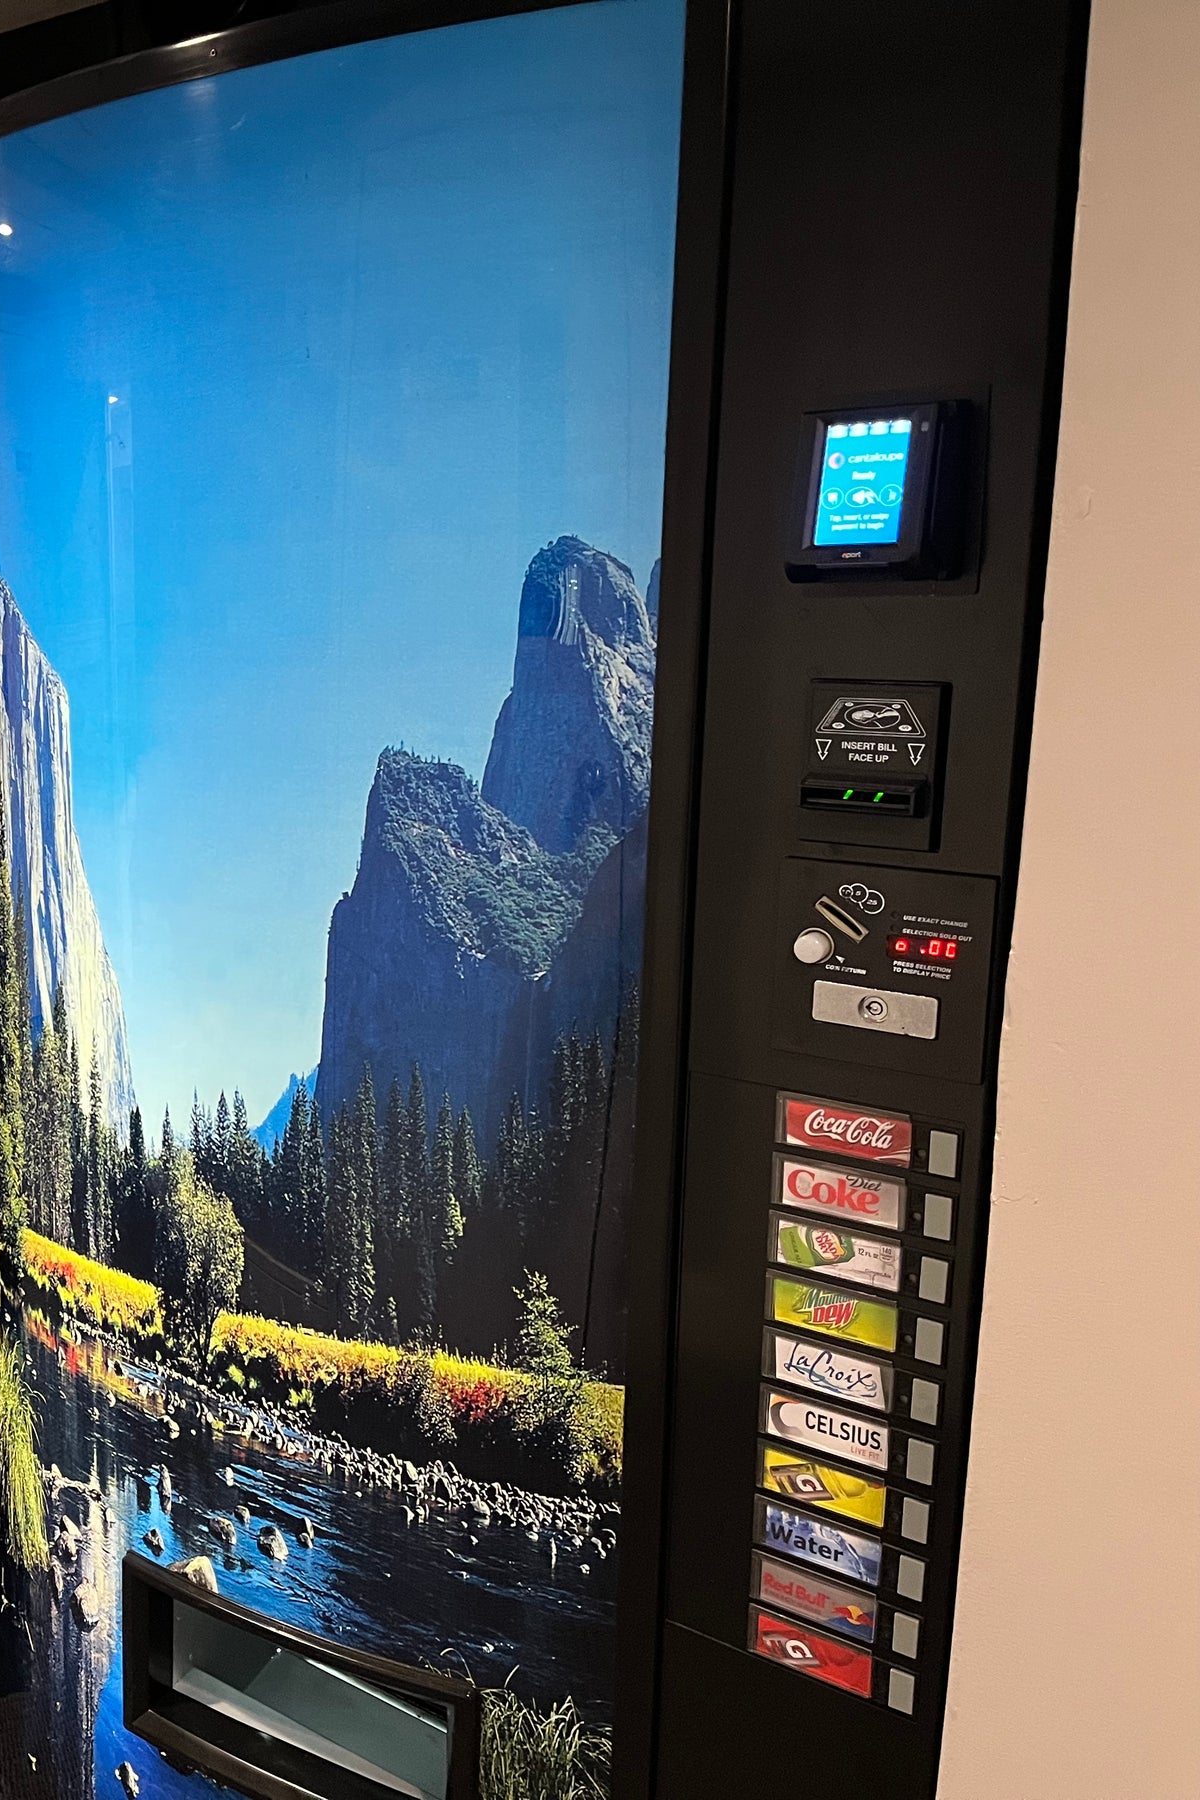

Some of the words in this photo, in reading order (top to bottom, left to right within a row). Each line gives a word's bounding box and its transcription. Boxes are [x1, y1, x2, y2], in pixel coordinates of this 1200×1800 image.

[848, 452, 904, 463] cantaloupe
[841, 741, 875, 751] INSERT
[878, 743, 898, 752] BILL
[849, 753, 873, 762] FACE
[875, 754, 889, 763] UP
[917, 916, 940, 924] EXACT
[940, 920, 968, 928] CHANGE
[902, 928, 938, 938] SELECTION
[893, 960, 914, 968] PRESS
[915, 963, 951, 973] SELECTION
[902, 968, 930, 976] DISPLAY
[930, 972, 951, 980] PRICE
[804, 1109, 896, 1149] Coca-Cola
[846, 1173, 882, 1192] Diet
[787, 1169, 880, 1214] Coke
[816, 1230, 840, 1260] ANADA
[816, 1236, 830, 1254] DRY
[858, 1248, 864, 1256] 12
[850, 1445, 867, 1456] LIVE
[868, 1449, 880, 1460] FIT
[770, 1522, 844, 1562] Water
[764, 1572, 794, 1596] Red
[796, 1585, 826, 1607] Bull
